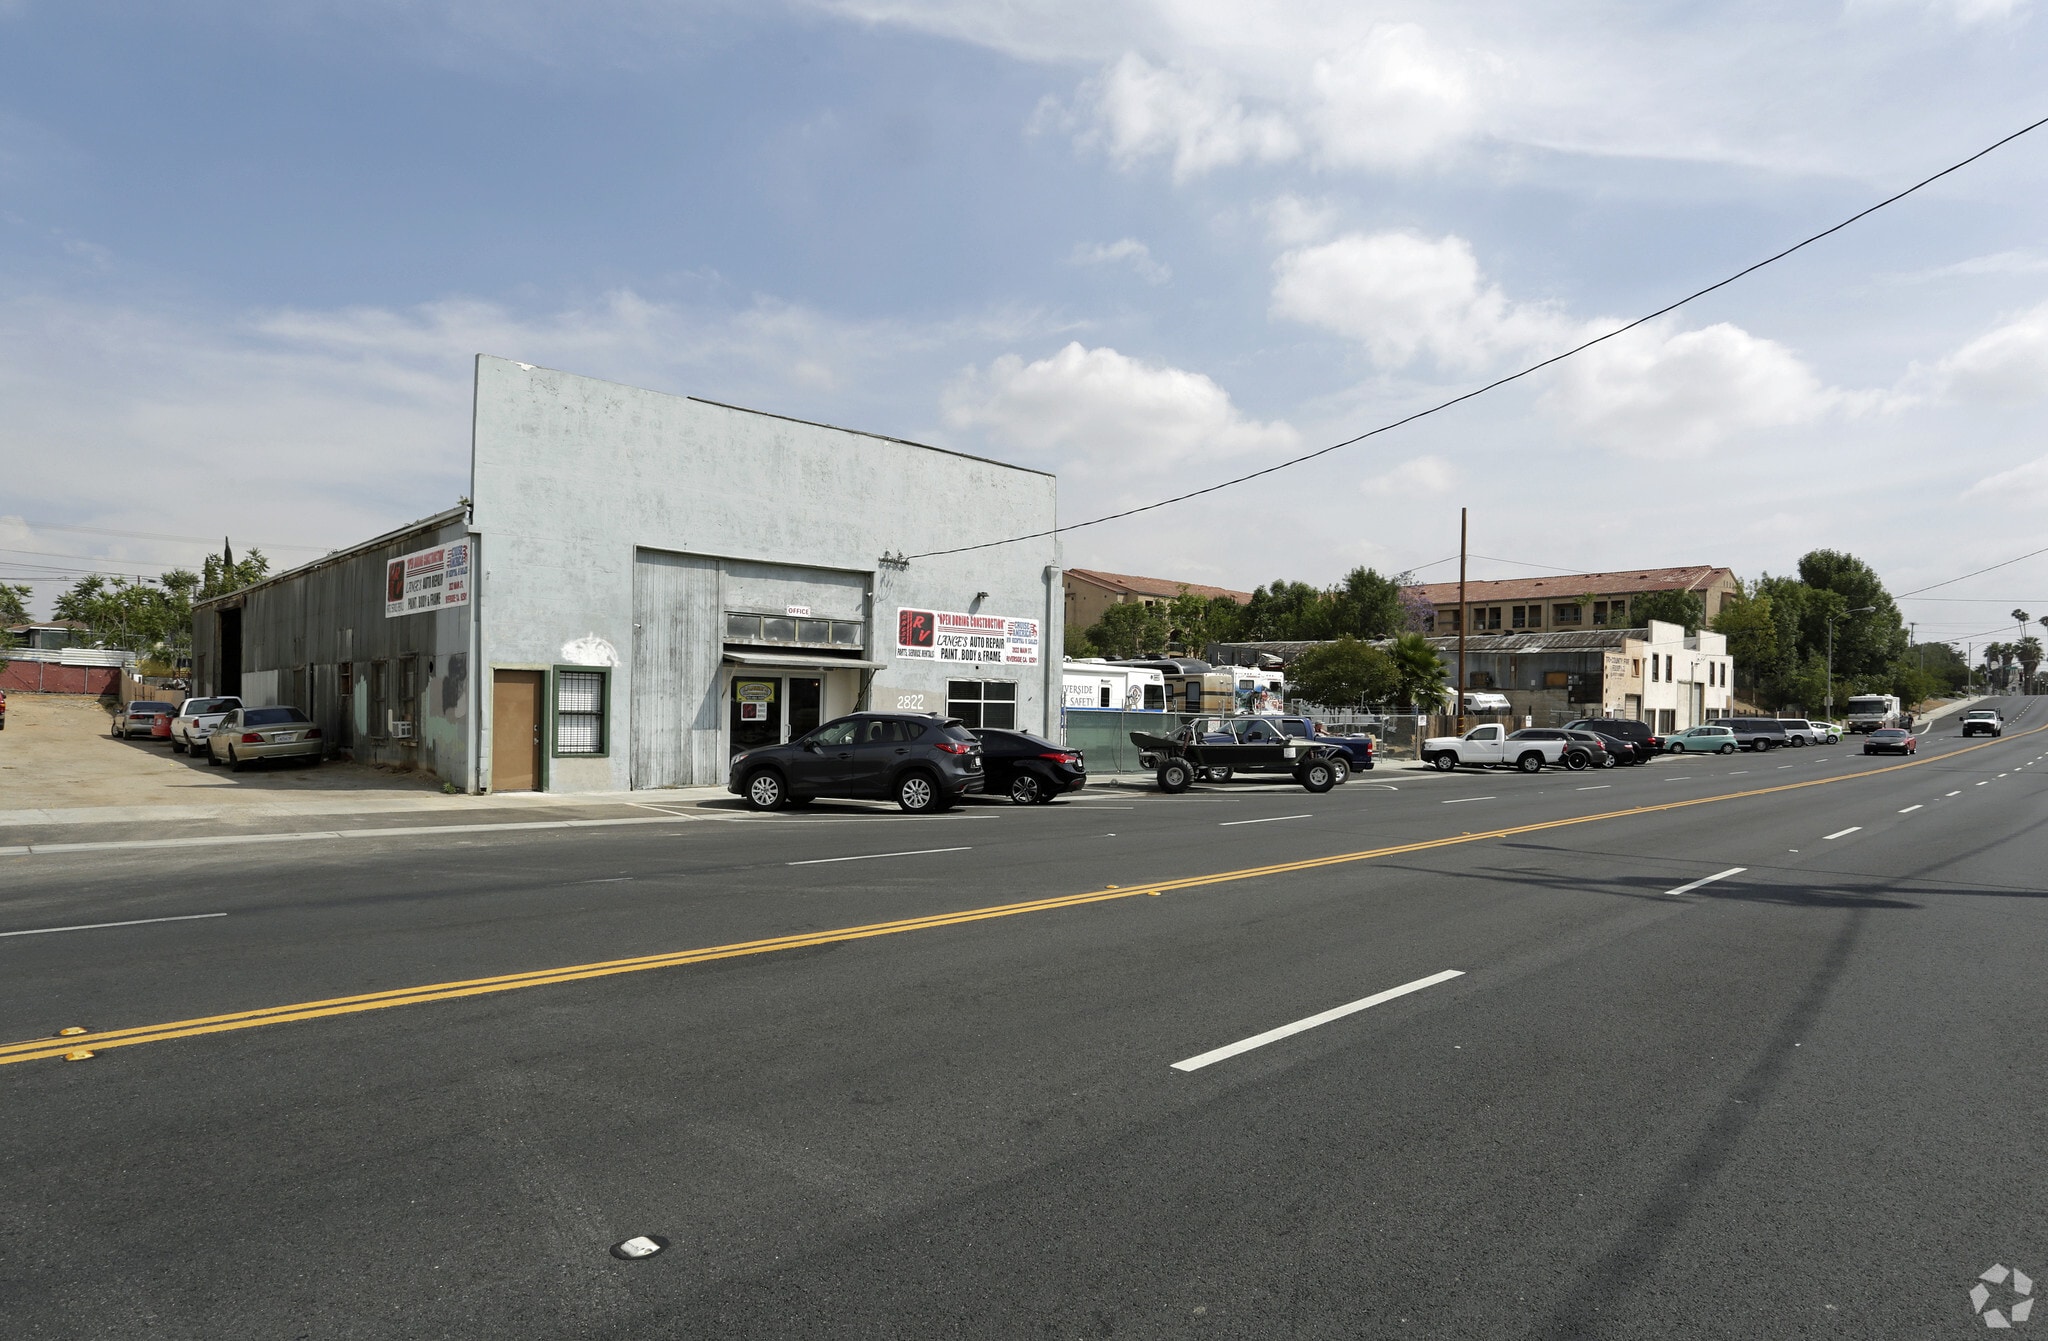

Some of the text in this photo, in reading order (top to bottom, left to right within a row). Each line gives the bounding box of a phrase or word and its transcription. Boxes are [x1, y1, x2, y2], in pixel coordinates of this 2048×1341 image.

[913, 616, 925, 628] R
[952, 615, 969, 627] DURING
[919, 630, 931, 642] V
[1013, 629, 1031, 637] AMERICA
[937, 635, 1004, 649] LANGE'S AUTO REPAIR
[962, 649, 977, 661] BODY
[978, 652, 982, 661] &
[983, 651, 1001, 662] FRAME
[897, 695, 923, 709] 2822
[1070, 697, 1094, 706] SAFETY
